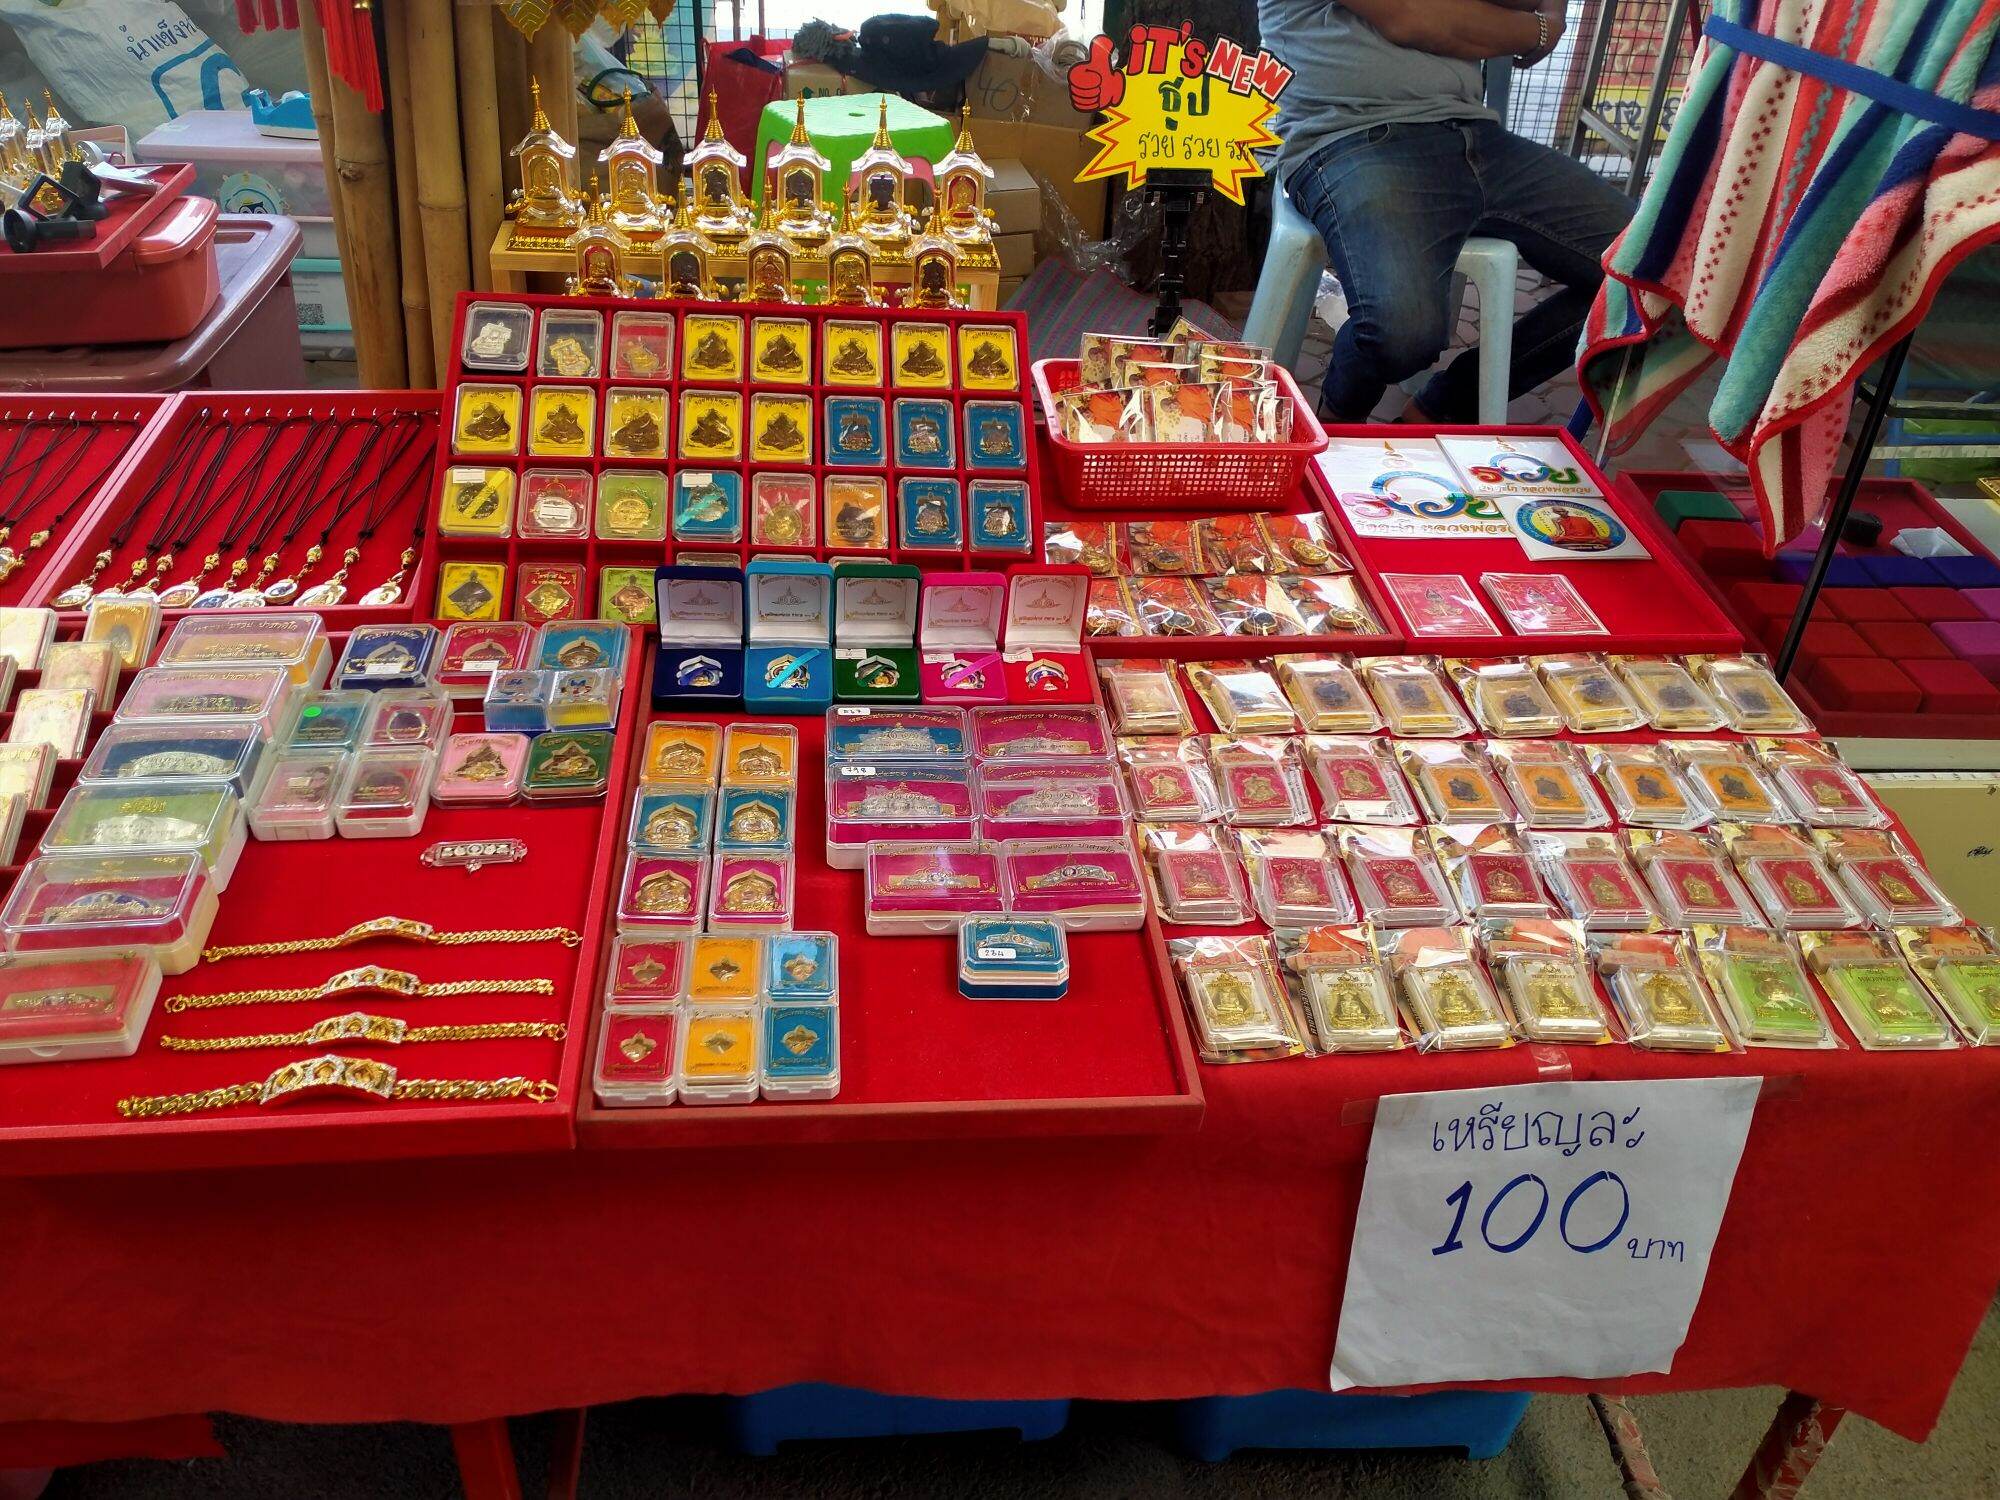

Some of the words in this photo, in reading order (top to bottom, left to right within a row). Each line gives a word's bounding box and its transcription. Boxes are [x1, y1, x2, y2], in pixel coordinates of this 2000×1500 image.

[1206, 35, 1295, 102] NEW
[1138, 132, 1175, 159] รวย
[1182, 134, 1220, 160] รวย
[1431, 1102, 1647, 1156] เหรียญละ
[1431, 1170, 1630, 1257] 100
[1626, 1237, 1686, 1264] บาท
